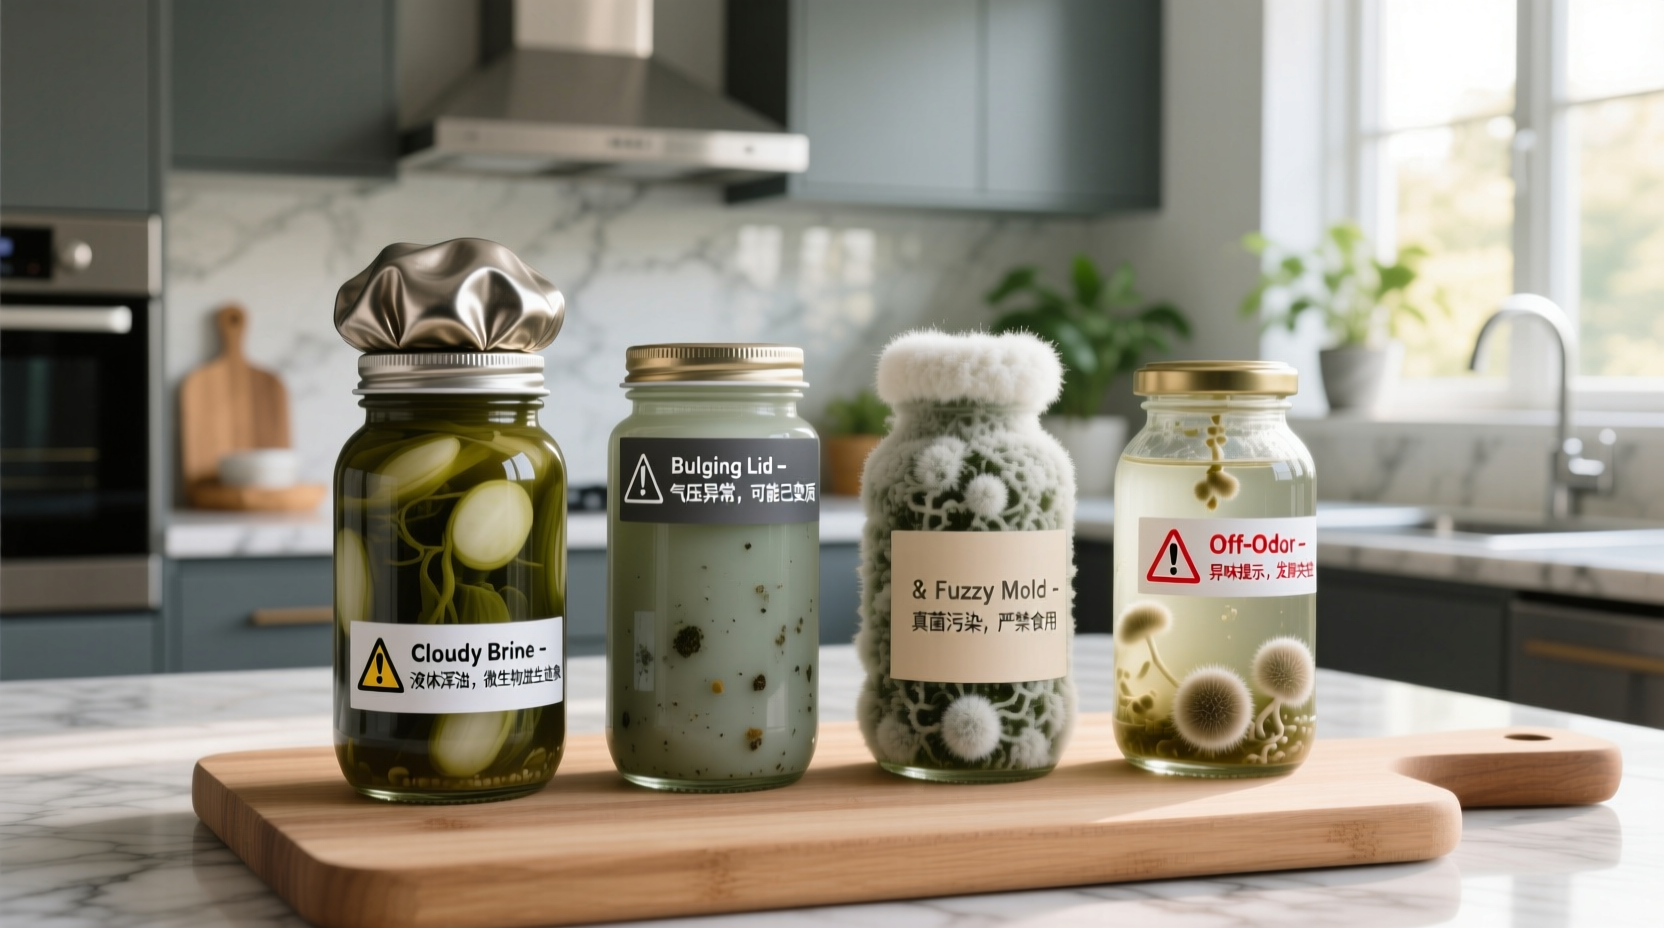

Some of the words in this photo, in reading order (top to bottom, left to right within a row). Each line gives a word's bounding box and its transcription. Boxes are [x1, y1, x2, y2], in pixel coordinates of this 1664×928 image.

[671, 456, 742, 479] Bulging
[748, 456, 773, 474] Lid
[1210, 533, 1295, 554] Off-Odor
[912, 579, 927, 600] &
[936, 580, 994, 605] Fuzzy
[1001, 578, 1046, 600] Mold
[411, 643, 482, 667] Cloudy
[488, 641, 534, 661] Brine
